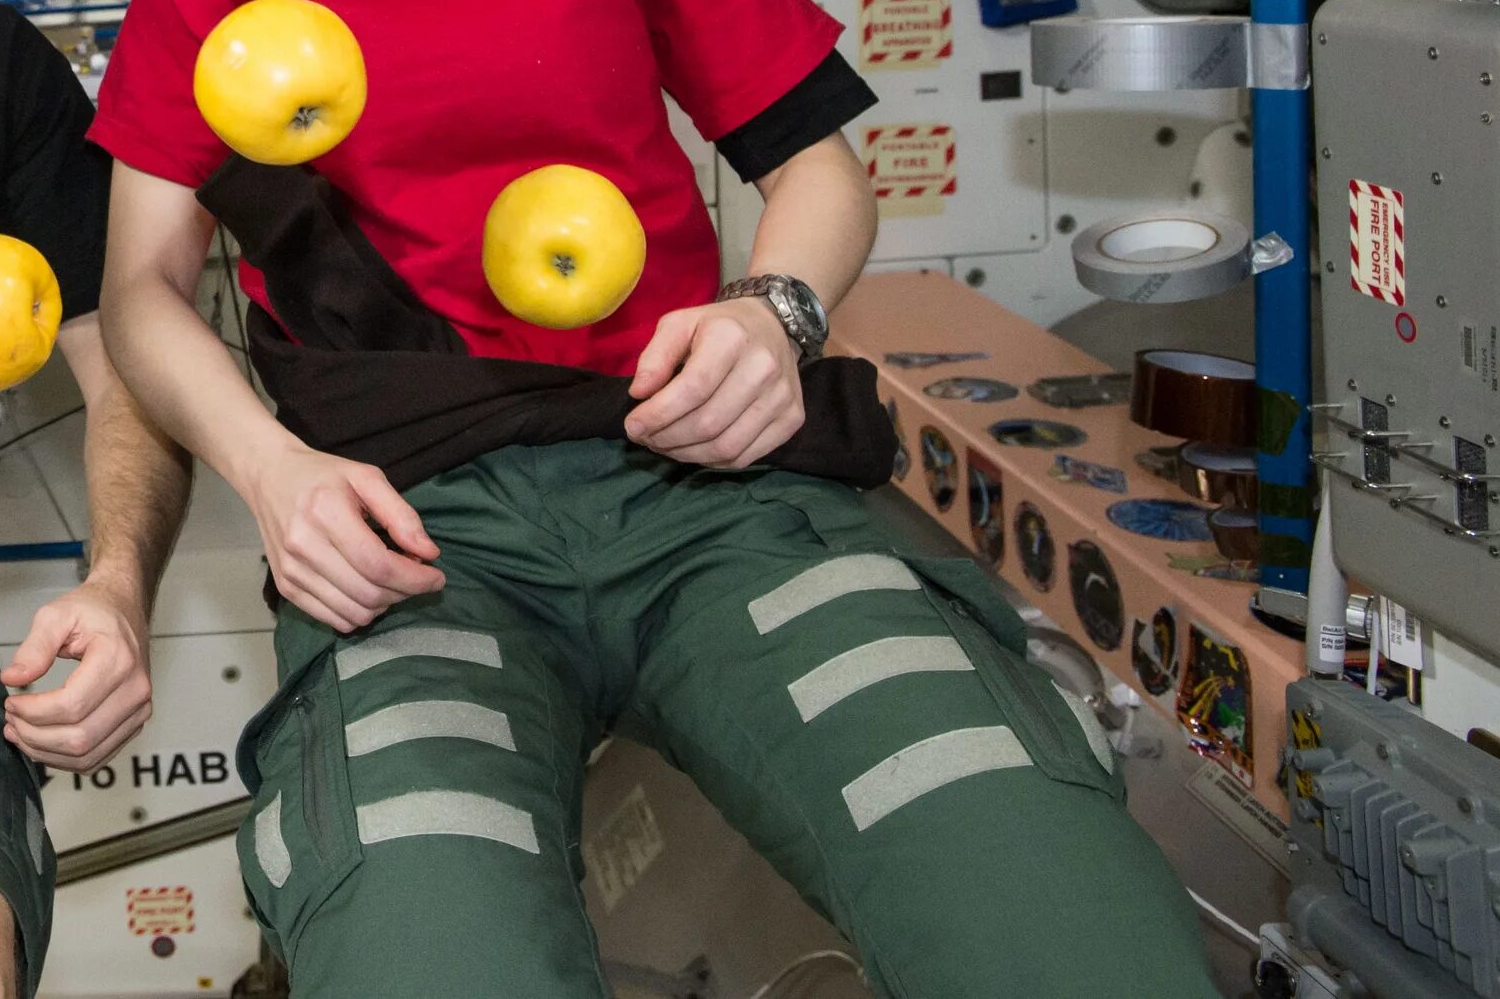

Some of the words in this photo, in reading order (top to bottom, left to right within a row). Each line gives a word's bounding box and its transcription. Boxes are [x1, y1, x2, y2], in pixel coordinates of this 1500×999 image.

[892, 157, 929, 169] FIRE
[1370, 199, 1380, 234] FIRE
[1382, 202, 1390, 265] EMERGENCY
[1371, 240, 1381, 285] PORT
[131, 752, 229, 788] HAB
